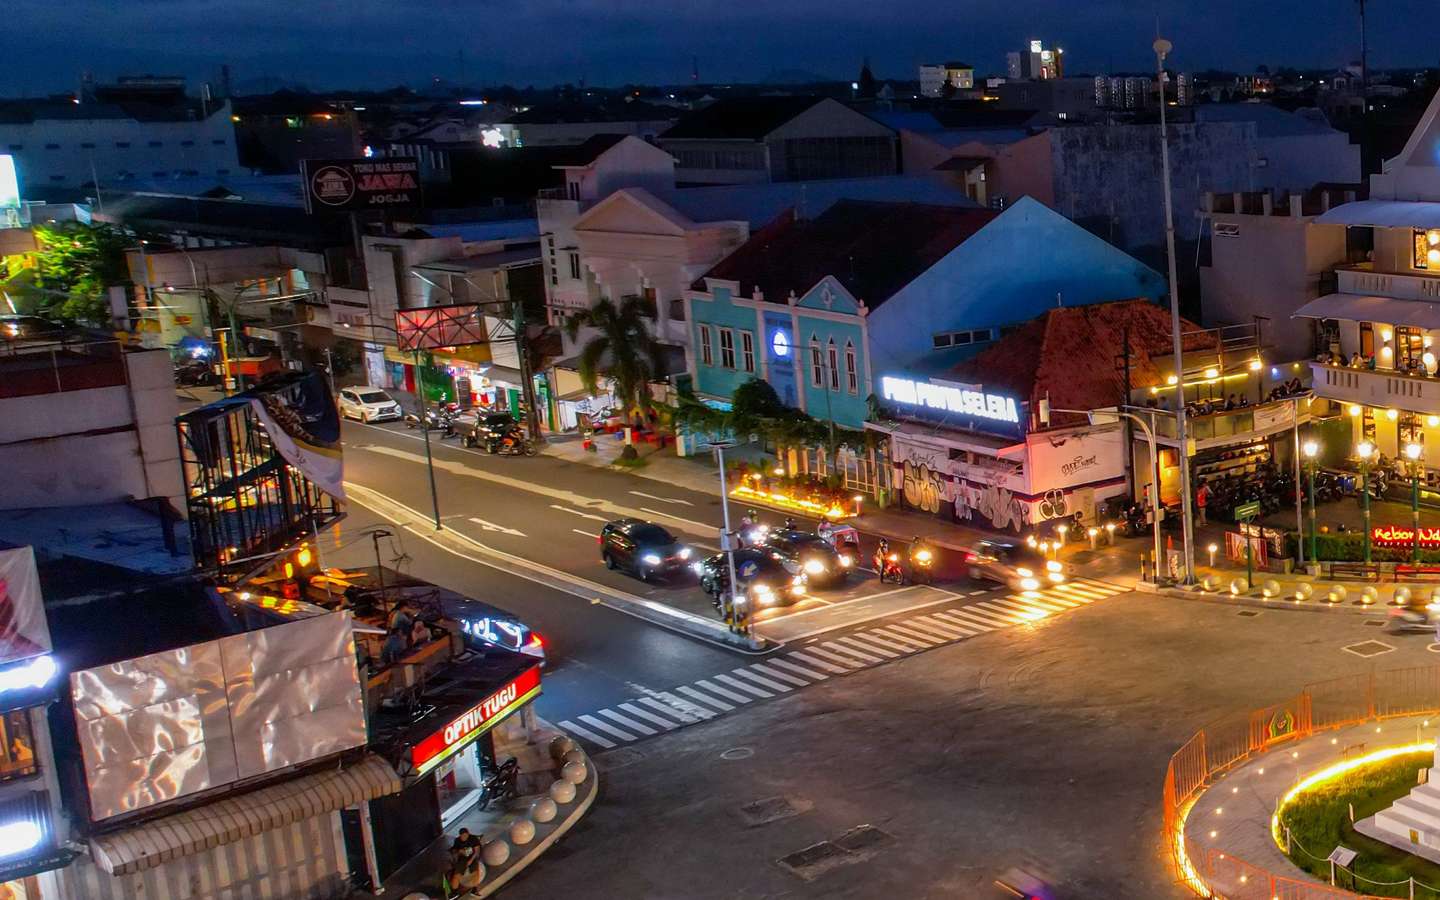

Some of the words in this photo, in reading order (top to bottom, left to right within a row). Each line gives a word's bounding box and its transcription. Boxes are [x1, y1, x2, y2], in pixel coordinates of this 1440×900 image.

[358, 173, 418, 191] JAWA
[368, 193, 411, 204] JOGJA
[443, 706, 484, 745] OPTIK
[483, 683, 517, 719] TUGU
